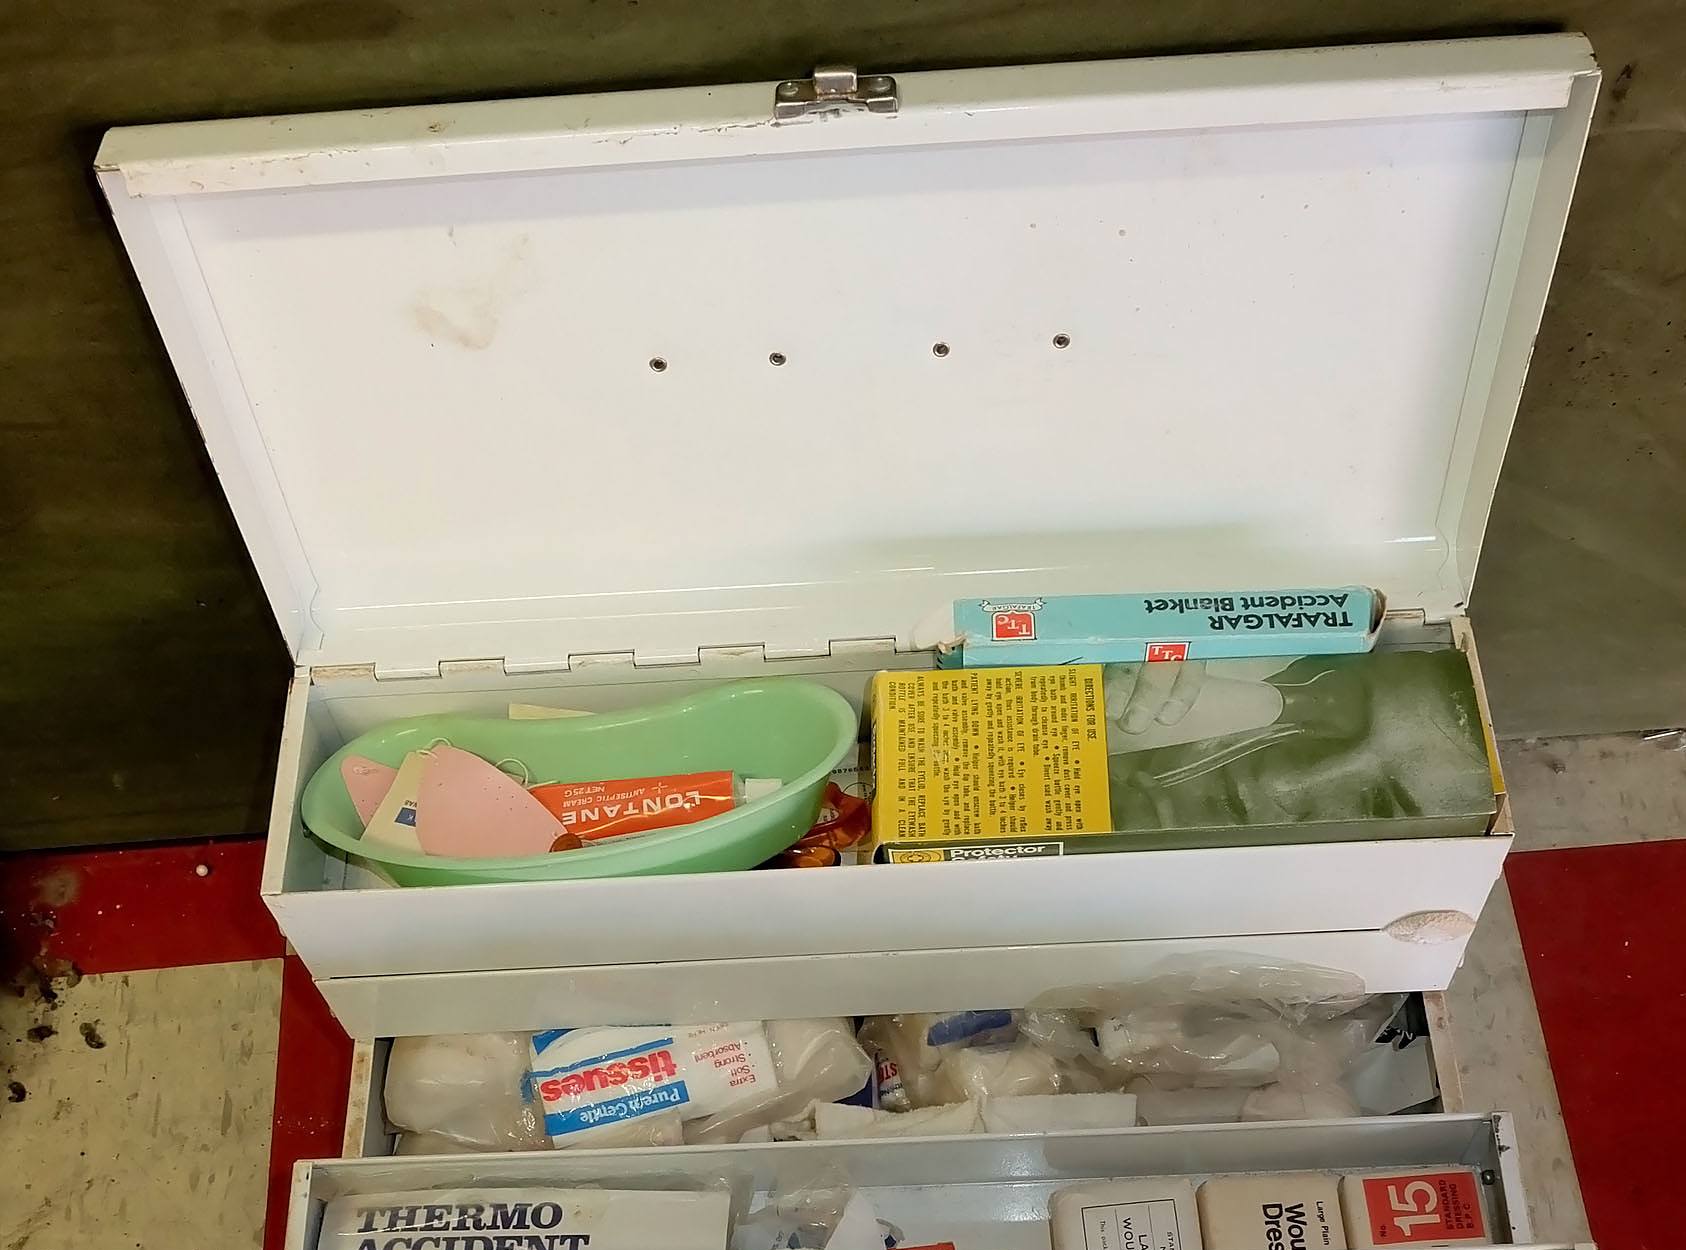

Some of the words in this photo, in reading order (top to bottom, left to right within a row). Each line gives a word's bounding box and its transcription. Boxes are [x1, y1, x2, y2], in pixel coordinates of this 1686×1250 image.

[1144, 597, 1234, 614] Blanket
[1241, 593, 1349, 610] Accident
[997, 615, 1031, 636] TTC
[1208, 611, 1353, 630] TRAFALGAR
[1084, 678, 1095, 712] DIRECTIONS
[1086, 714, 1096, 726] FOR
[562, 797, 593, 808] CREAM
[596, 788, 646, 802] ANTISEPTIC
[562, 790, 702, 826] LONTANE
[950, 845, 1046, 857] Protector
[694, 1042, 741, 1063] Absorbent
[714, 1053, 746, 1068] Strong
[540, 1050, 677, 1102] tissues
[729, 1074, 756, 1087] Extra
[730, 1064, 751, 1077] Soft
[1386, 1180, 1441, 1237] 15
[1439, 1179, 1455, 1230] STANDARD
[1450, 1183, 1465, 1229] DRESSING
[356, 1202, 563, 1233] THERMO
[1316, 1200, 1325, 1223] Large
[1321, 1225, 1330, 1246] Plain
